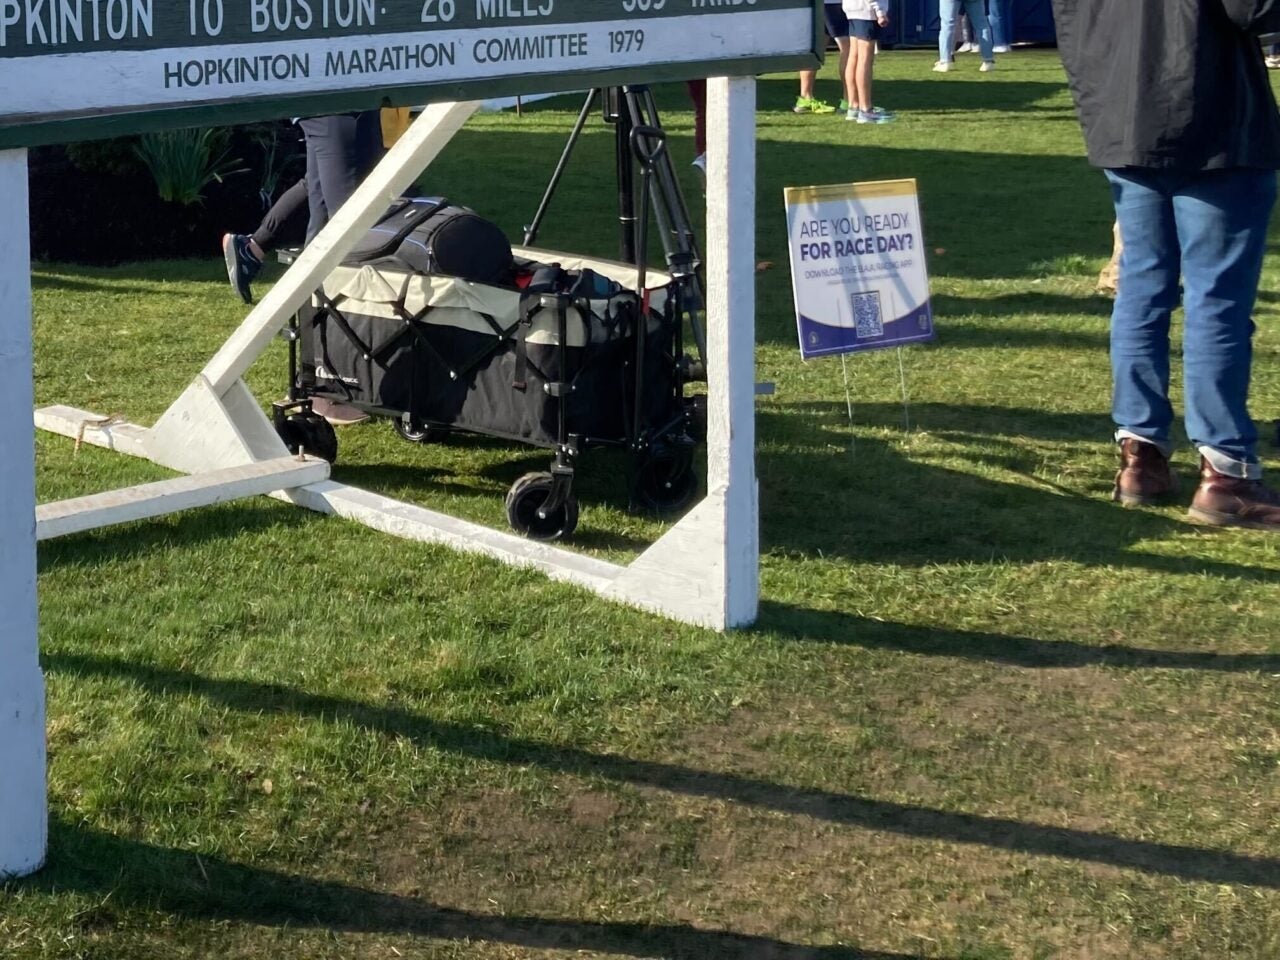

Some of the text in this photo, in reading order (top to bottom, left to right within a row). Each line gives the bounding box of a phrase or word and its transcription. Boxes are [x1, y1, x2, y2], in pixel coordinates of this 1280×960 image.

[163, 29, 645, 89] HOPKINTON MARATHON COMMITTEE 1979
[800, 212, 909, 239] ARE YOU READY
[800, 233, 914, 261] FOR RACE DAY?
